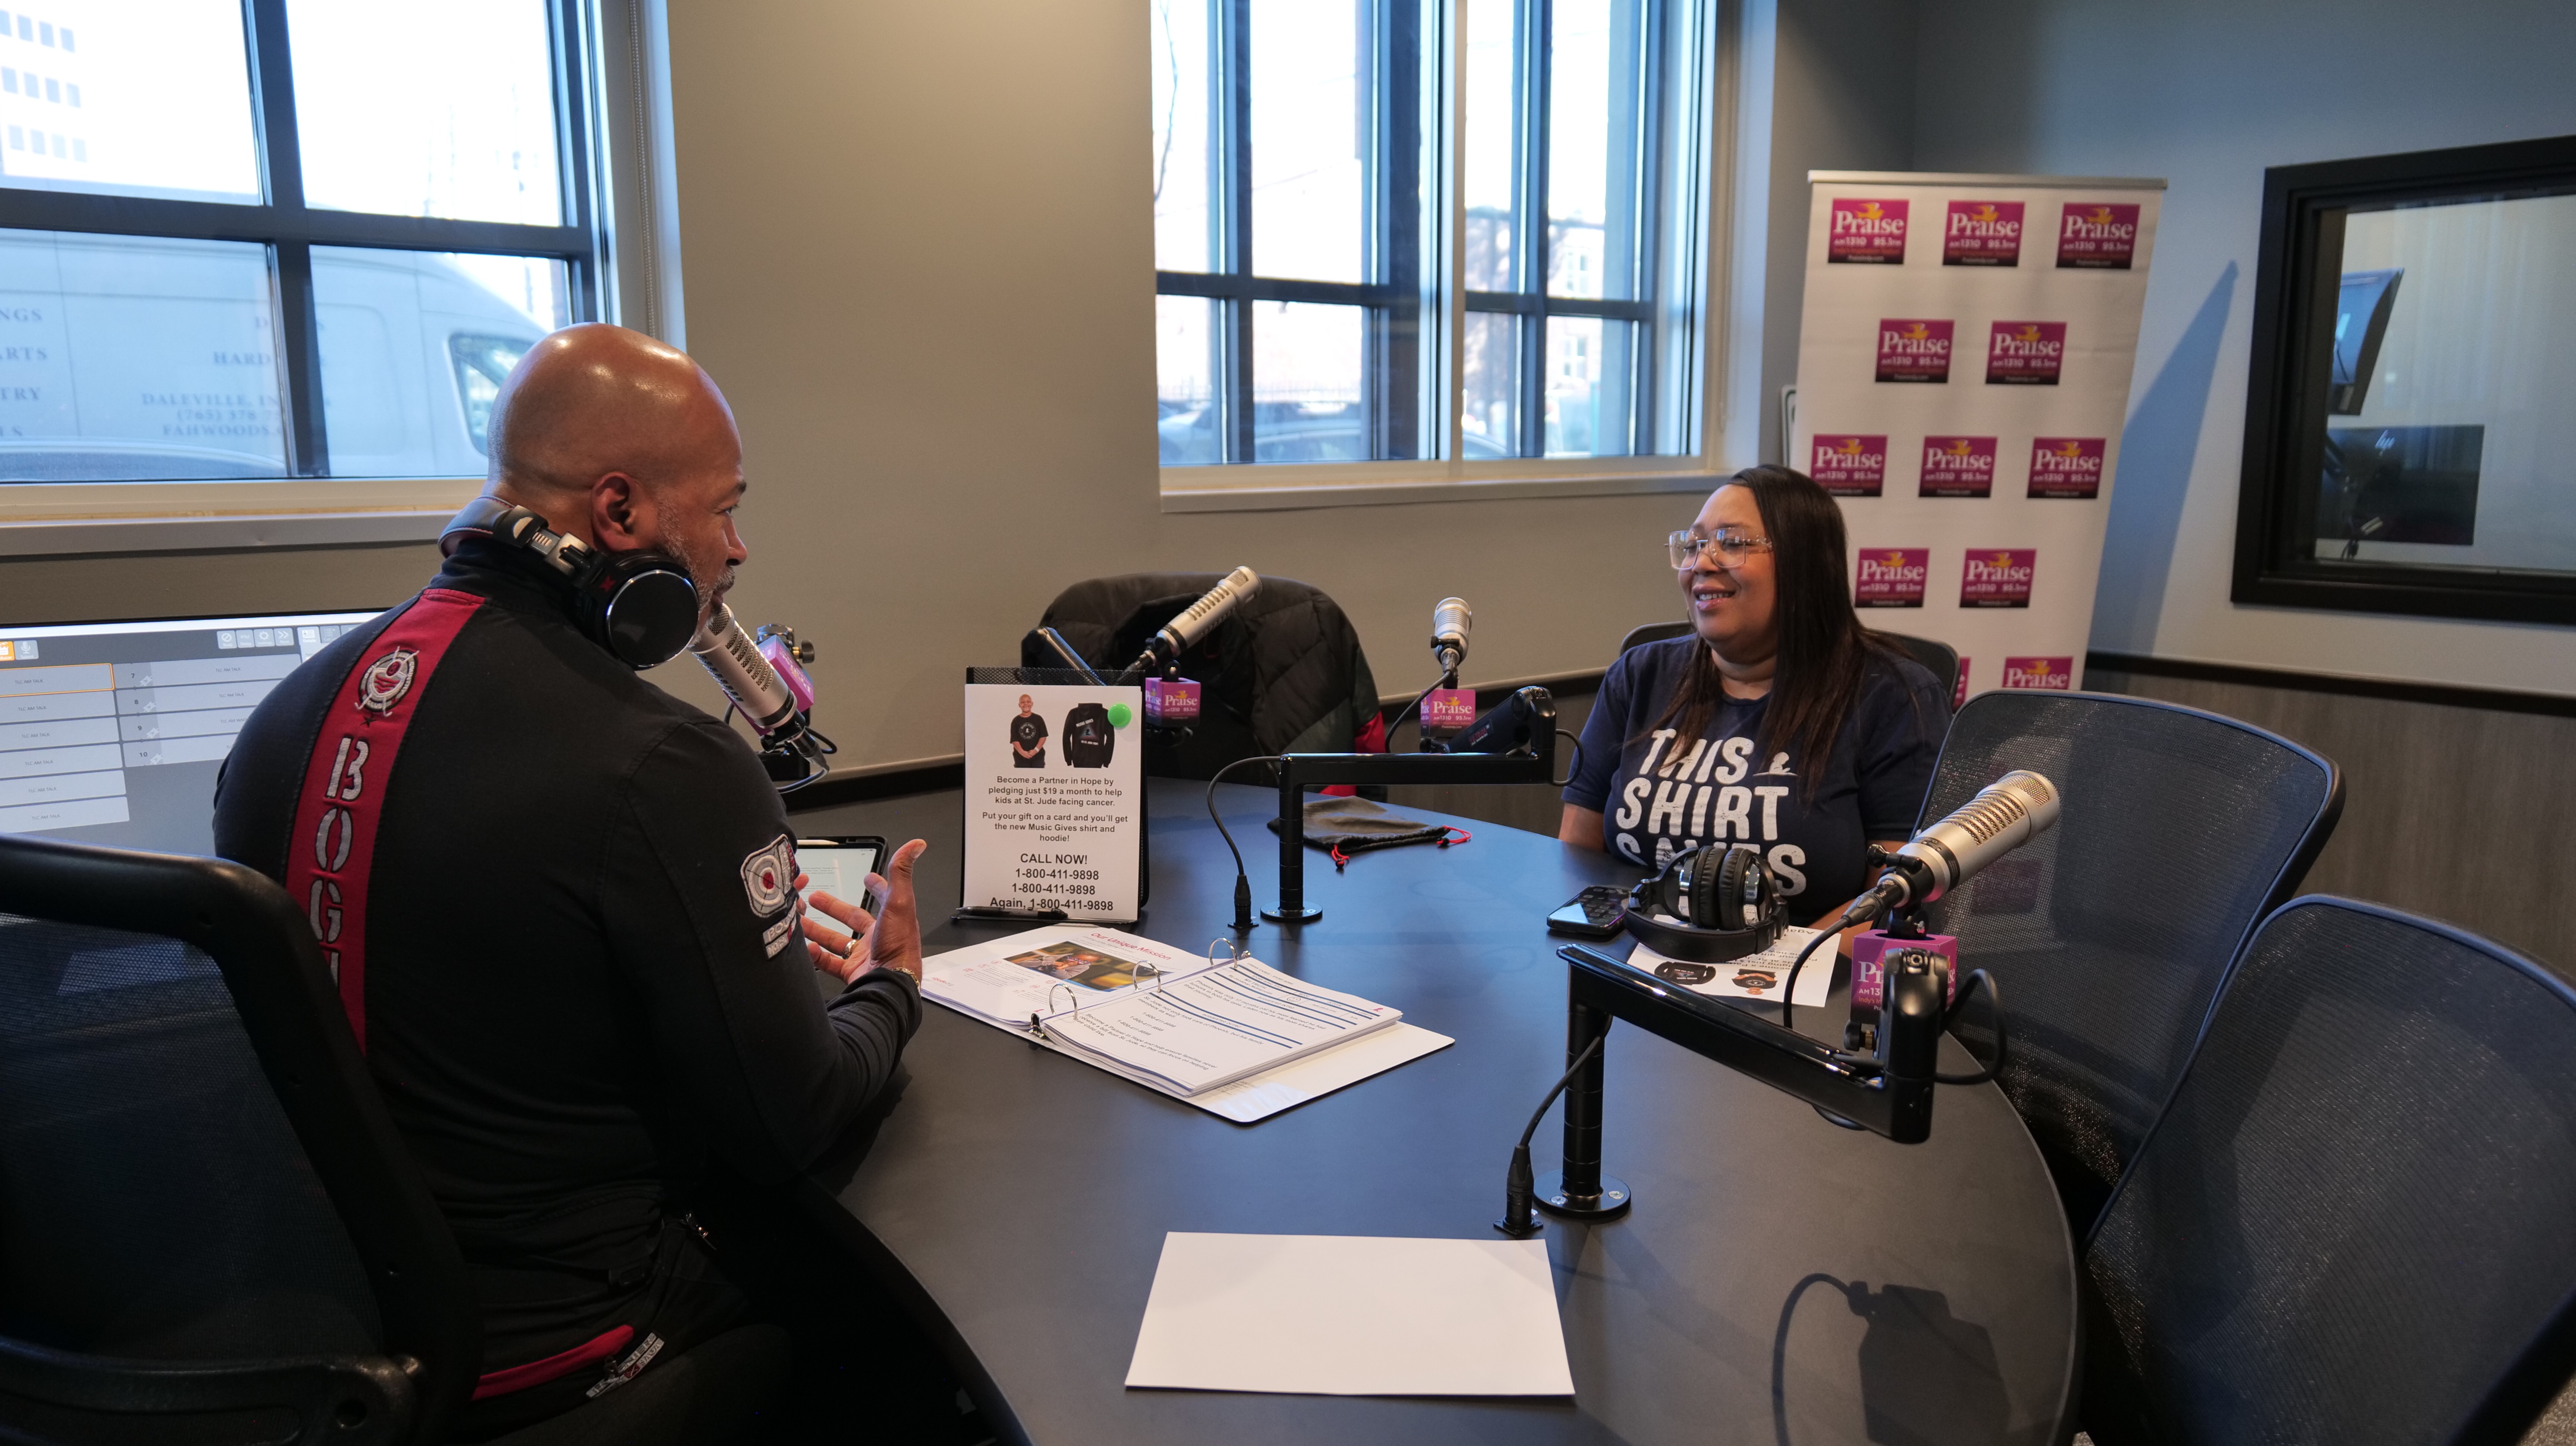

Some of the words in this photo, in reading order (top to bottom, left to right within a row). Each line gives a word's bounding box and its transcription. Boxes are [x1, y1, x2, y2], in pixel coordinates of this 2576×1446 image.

[1833, 210, 1904, 235] Praise
[1948, 213, 2019, 238] Praise
[2063, 215, 2133, 239] Praise
[0, 347, 47, 361] RTS
[1880, 331, 1949, 355] Praise
[1992, 333, 2060, 358] Praise
[1814, 446, 1882, 469] Praise
[1925, 447, 1992, 471] Praise
[2034, 449, 2100, 472] Praise
[1860, 559, 1924, 581] Praise
[1965, 559, 2031, 582] Praise
[2006, 668, 2068, 687] Praise
[1165, 695, 1197, 705] Praise
[1433, 701, 1472, 714] Praise
[1639, 728, 1755, 785] THIS
[988, 787, 1023, 795] pledging
[1081, 778, 1101, 786] Hope
[1104, 778, 1114, 786] by
[1059, 798, 1083, 807] facing
[1616, 778, 1789, 841] SHIRT
[1020, 854, 1052, 863] CALL
[1056, 854, 1088, 864] NOW!
[1015, 868, 1099, 880] 1-800-411-9898
[1012, 883, 1095, 895] 1-800-411-9898
[990, 897, 1026, 908] Again,
[1030, 899, 1113, 911] 1-800-411-9898
[1108, 938, 1138, 949] Unique
[1137, 947, 1171, 960] Mission
